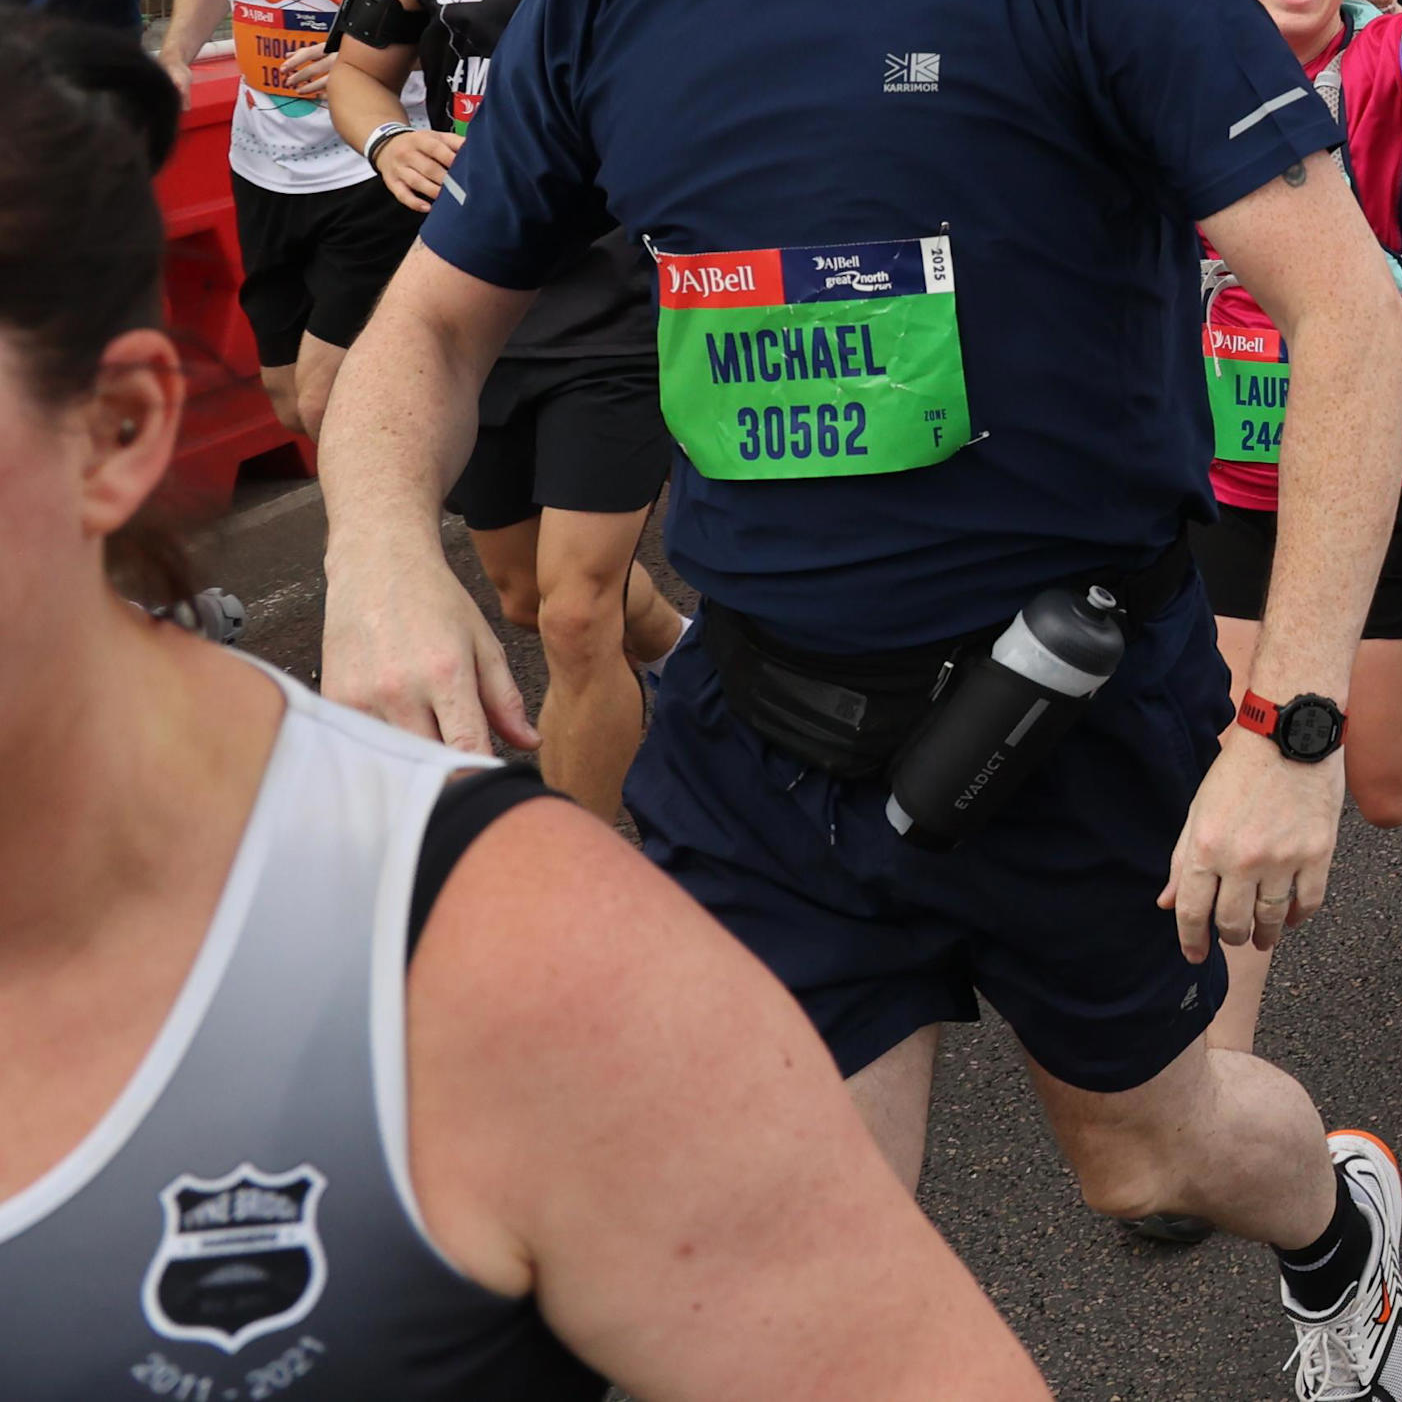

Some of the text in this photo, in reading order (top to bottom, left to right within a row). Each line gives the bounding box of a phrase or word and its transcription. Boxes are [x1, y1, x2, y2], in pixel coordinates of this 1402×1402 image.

[256, 35, 318, 59] THOM
[884, 83, 939, 93] KARRIMOR
[825, 271, 889, 289] great north
[930, 248, 946, 281] 2025
[681, 266, 755, 297] AJBell
[705, 324, 887, 384] MICHAEL
[1222, 334, 1264, 354] AJBell
[1236, 374, 1289, 409] LAUR
[924, 409, 947, 422] ZONE
[737, 402, 868, 461] 30562
[933, 427, 943, 448] F
[1241, 420, 1284, 452] 244
[954, 751, 1005, 810] EVADICT
